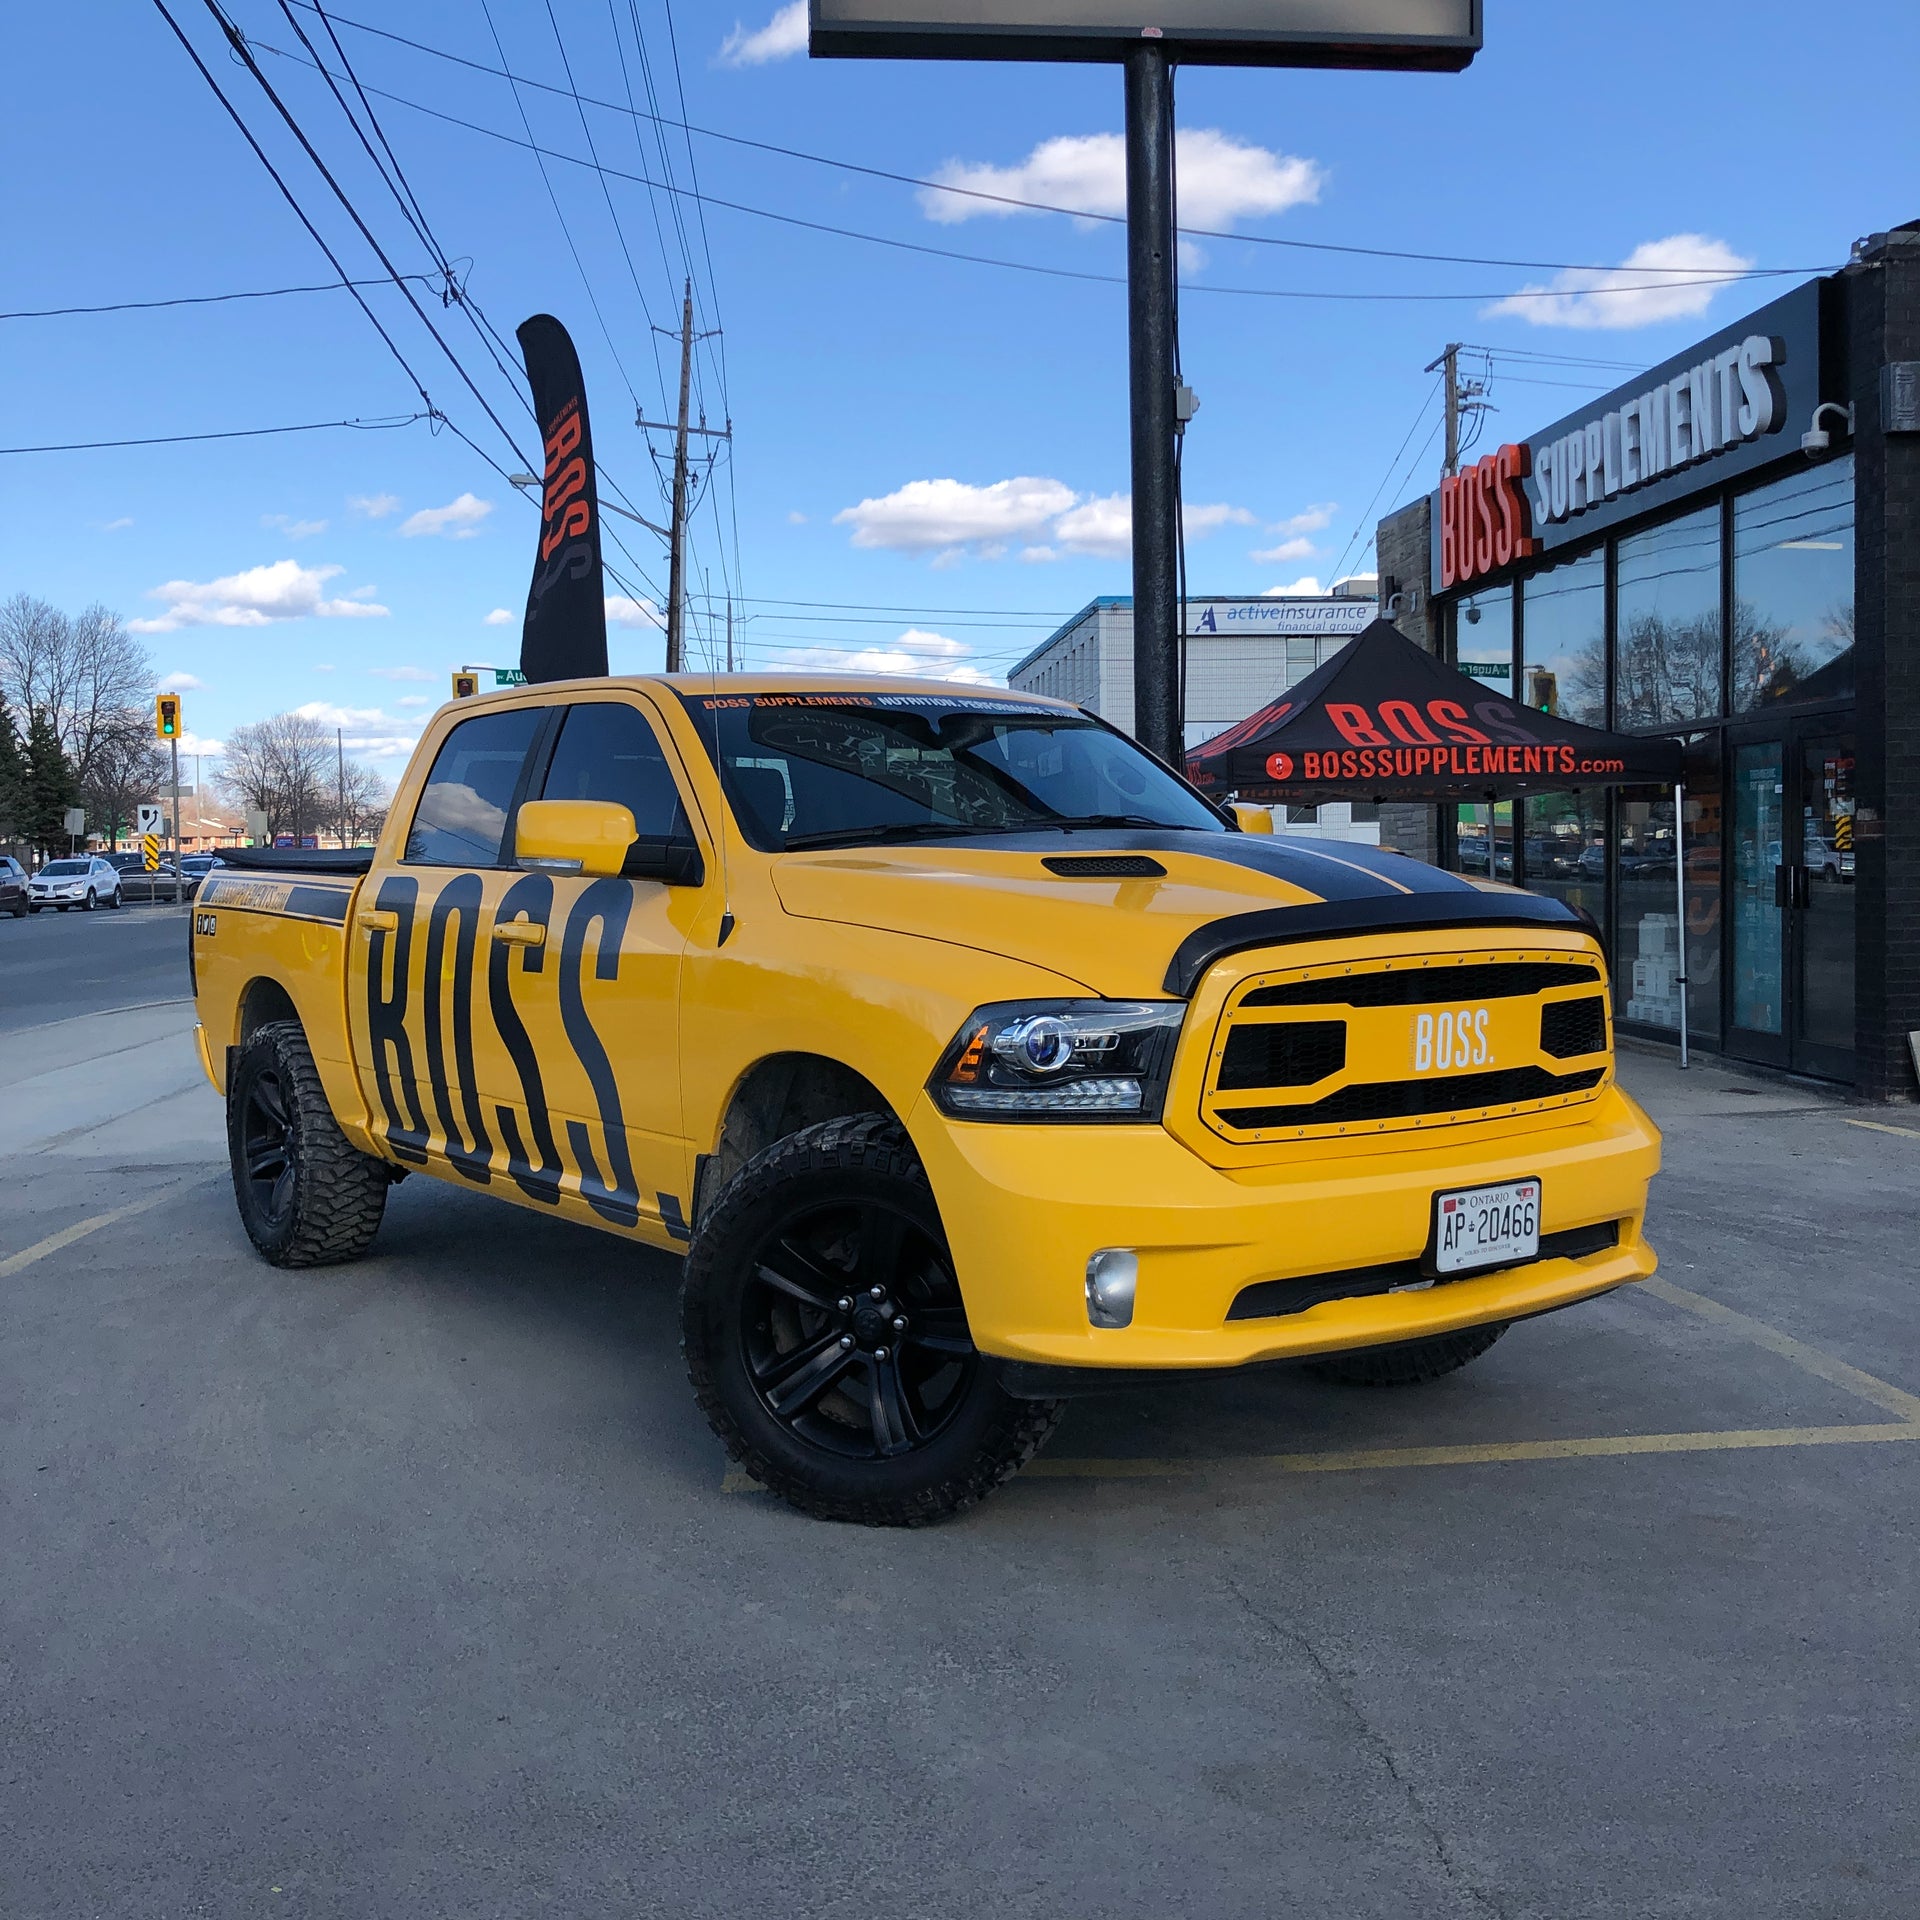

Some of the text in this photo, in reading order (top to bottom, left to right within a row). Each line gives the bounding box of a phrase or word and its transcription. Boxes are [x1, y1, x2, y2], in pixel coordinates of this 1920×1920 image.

[1534, 335, 1776, 526] SUPPLEMENTS
[1227, 604, 1367, 620] activeinsurance
[1277, 622, 1363, 633] financial group
[703, 698, 750, 710] BOSS
[1305, 744, 1624, 779] BOSSSUPPLEMENTS.com
[1415, 1008, 1494, 1071] BOSS.
[1443, 1202, 1534, 1251] AP 20466
